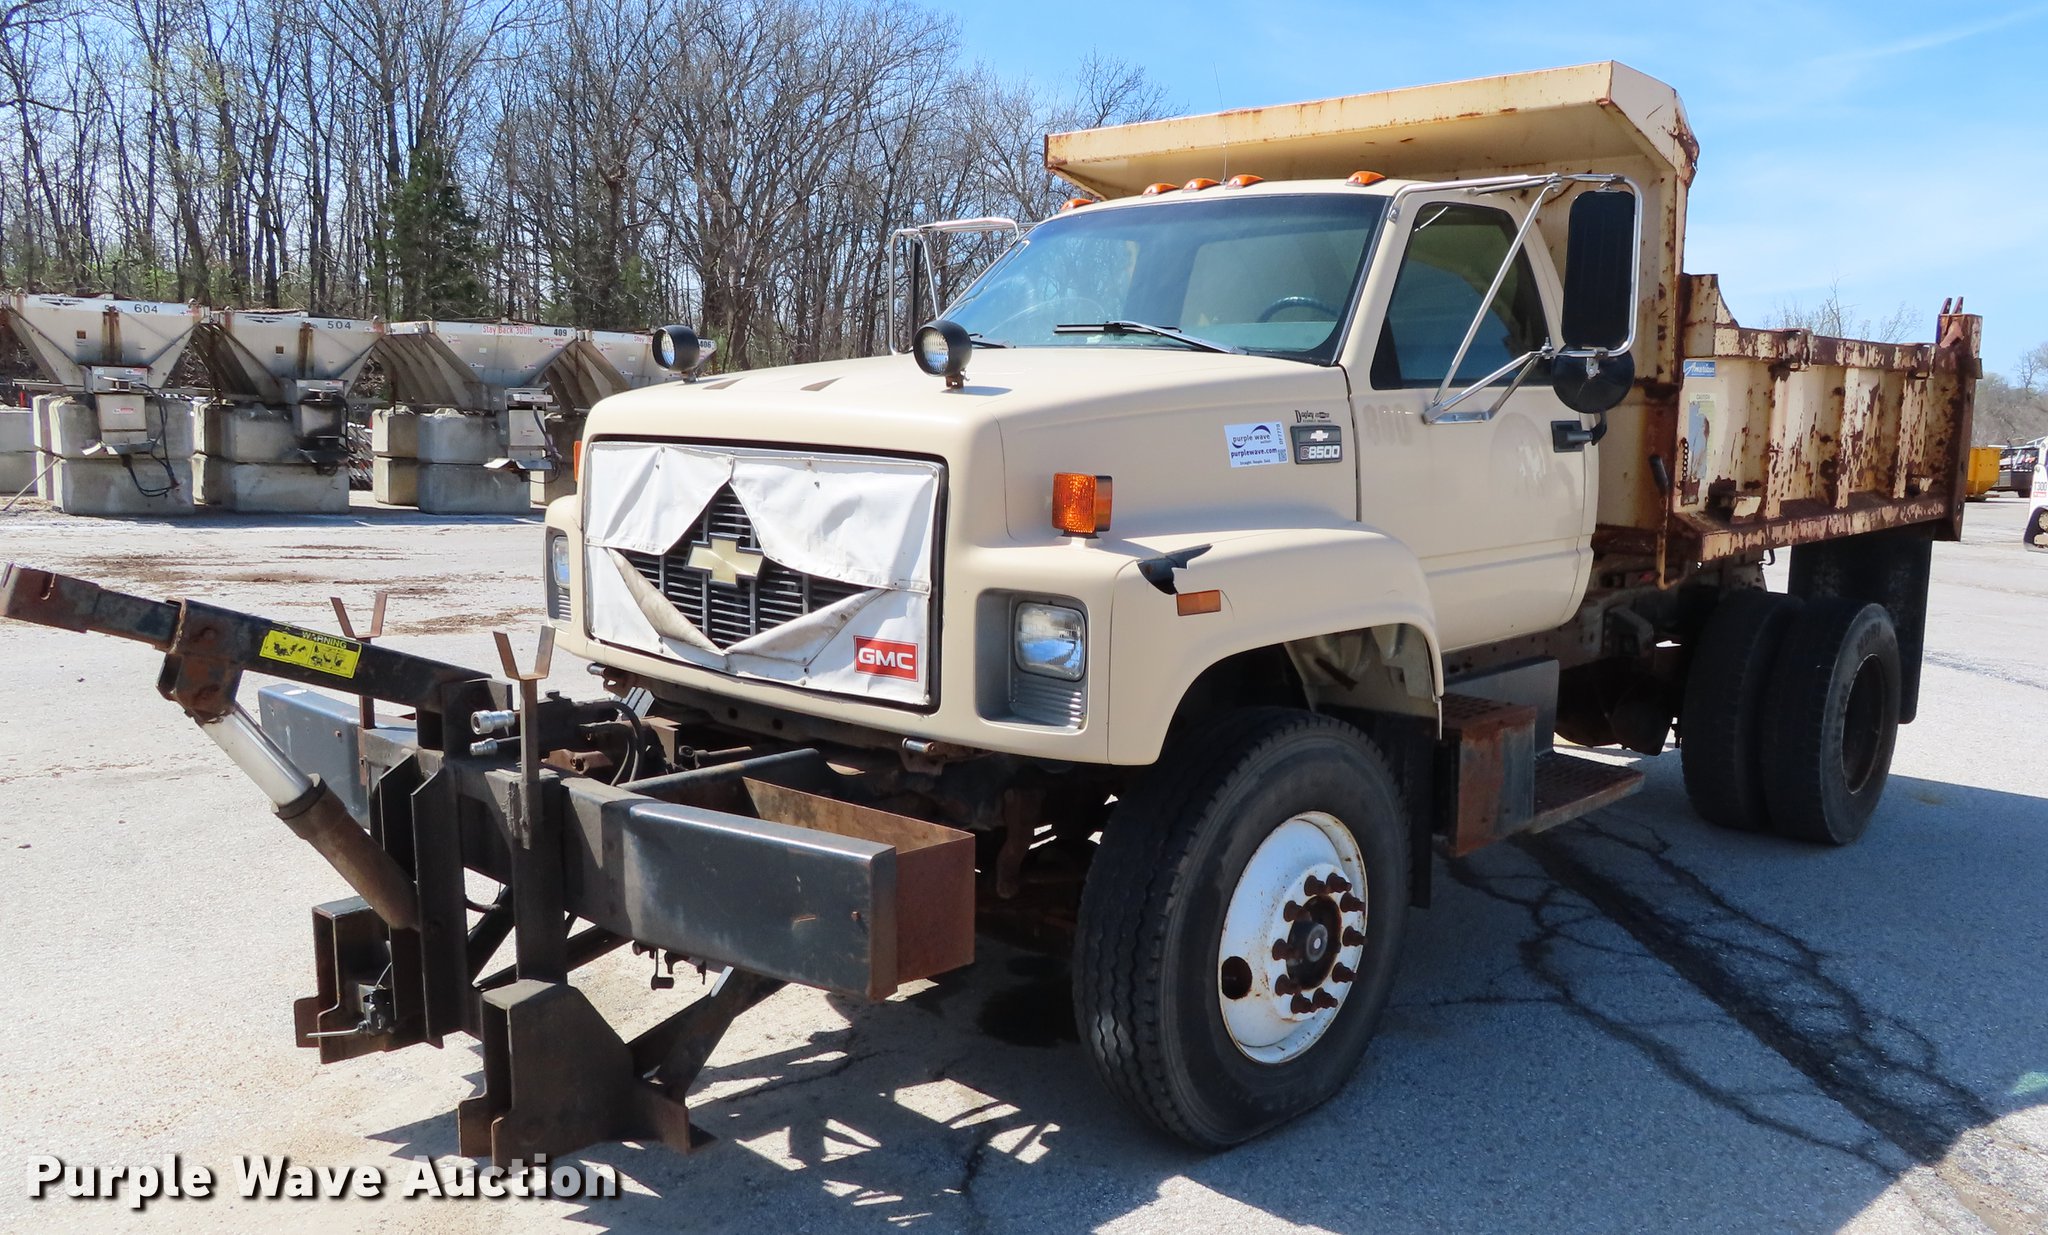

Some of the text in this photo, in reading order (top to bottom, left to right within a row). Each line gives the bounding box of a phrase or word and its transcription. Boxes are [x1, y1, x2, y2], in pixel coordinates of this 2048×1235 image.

[134, 303, 159, 314] 604
[327, 320, 352, 330] 504
[482, 325, 533, 335] Stay Back 300ft
[553, 328, 568, 337] 409
[1232, 434, 1253, 443] purple
[1254, 433, 1271, 441] wave
[1230, 447, 1278, 459] purplewave.com
[301, 630, 348, 650] WARNING
[857, 646, 914, 671] GMC
